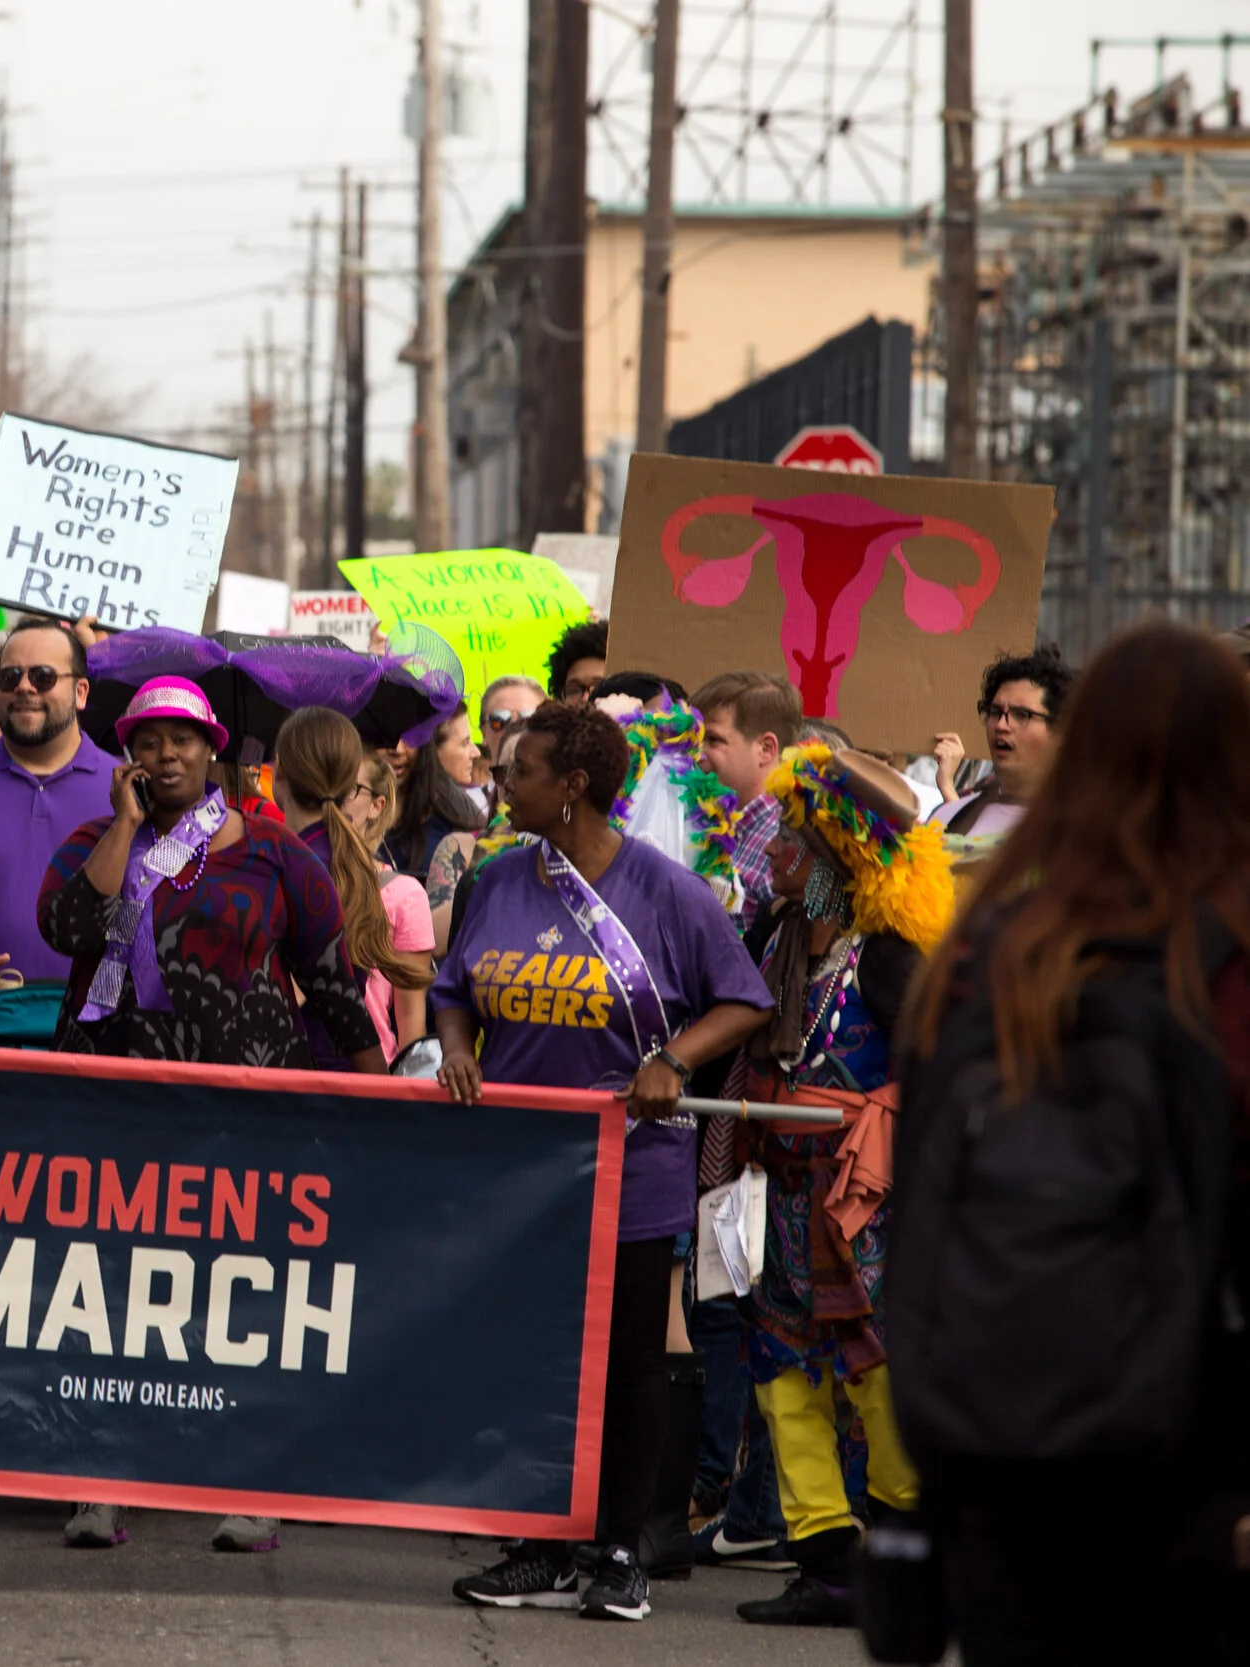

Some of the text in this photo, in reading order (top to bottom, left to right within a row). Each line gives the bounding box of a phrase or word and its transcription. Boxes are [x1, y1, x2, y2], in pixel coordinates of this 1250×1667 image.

[21, 430, 183, 496] Women's
[45, 474, 171, 528] Rights
[6, 525, 142, 584] Human
[55, 518, 115, 544] are
[19, 566, 160, 628] Rights
[471, 949, 611, 993] GEAUX
[474, 986, 615, 1029] TIGERS
[60, 1374, 87, 1400] ON
[93, 1376, 135, 1404] NEW
[140, 1380, 225, 1412] ORLEANS
